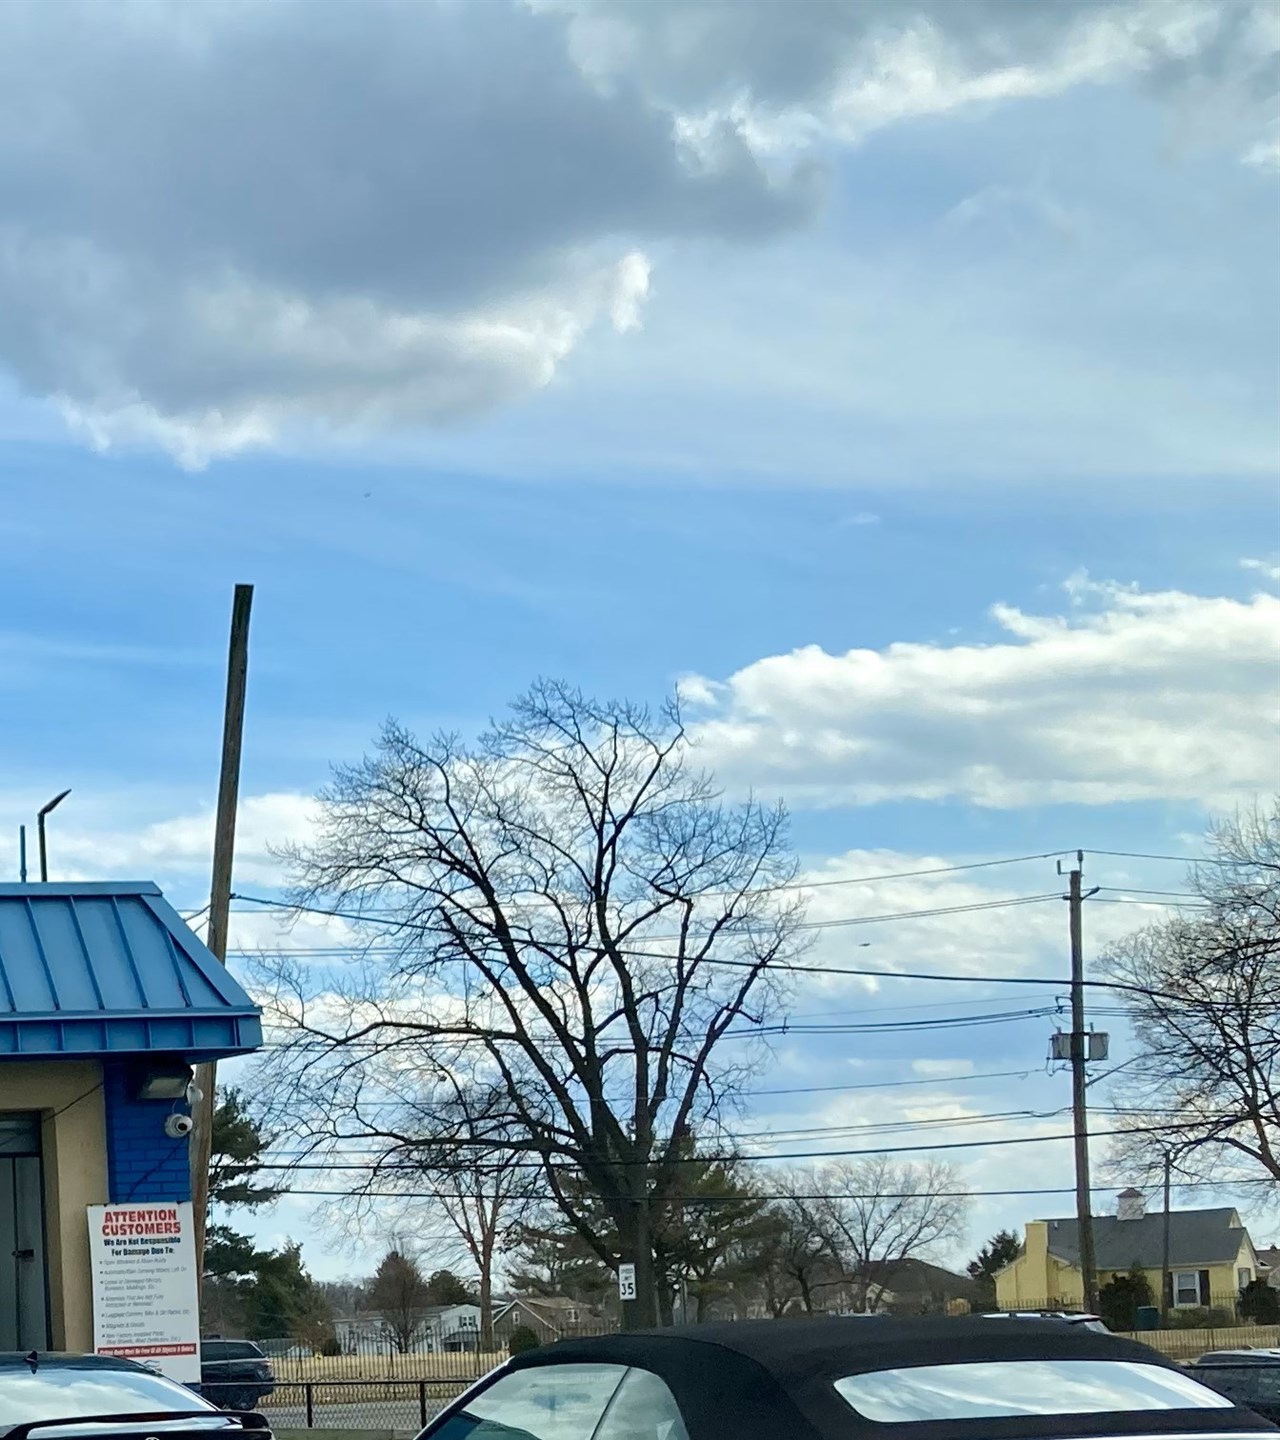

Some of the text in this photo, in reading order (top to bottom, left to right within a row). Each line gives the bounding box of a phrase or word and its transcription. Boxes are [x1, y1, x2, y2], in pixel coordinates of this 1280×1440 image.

[104, 1209, 176, 1224] ATTENTION
[102, 1222, 181, 1236] CUSTOMERS
[116, 1238, 127, 1246] Are
[141, 1236, 181, 1245] Responsible
[123, 1248, 150, 1256] Damage
[621, 1282, 634, 1295] 35
